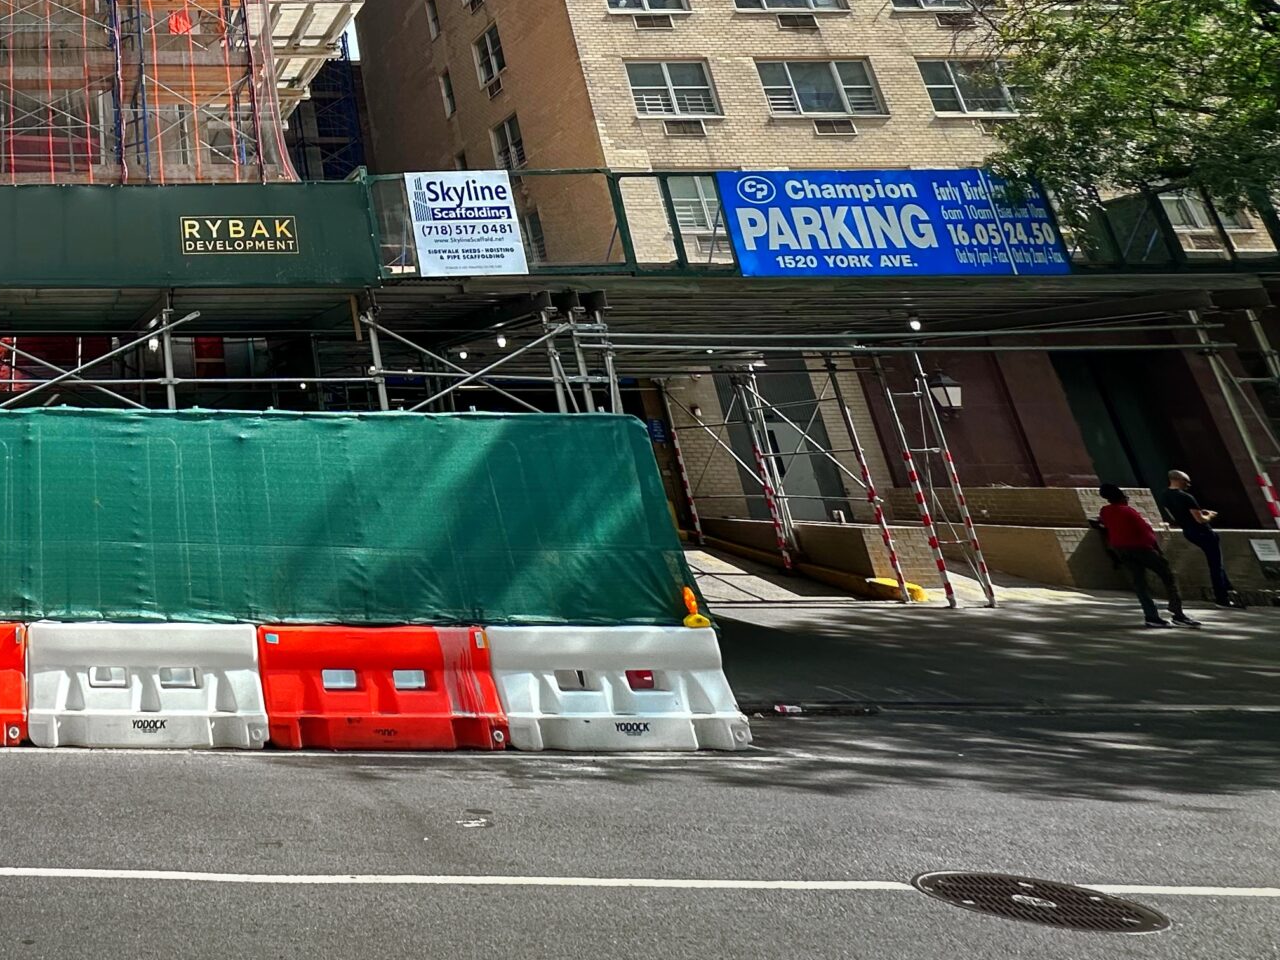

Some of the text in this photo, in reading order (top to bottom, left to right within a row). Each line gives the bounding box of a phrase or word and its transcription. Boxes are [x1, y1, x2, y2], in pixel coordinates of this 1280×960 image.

[426, 179, 507, 208] Skyline
[785, 179, 918, 202] Champion
[932, 180, 961, 205] Early
[960, 180, 987, 201] Bird
[434, 208, 508, 220] Scaffolding
[941, 205, 993, 220] 6am 10am
[184, 219, 293, 239] RYBAK
[422, 224, 513, 237] (718) 517.0481
[736, 204, 939, 251] PARKING
[946, 223, 1002, 246] 16.05
[1003, 222, 1056, 245] 24.50
[185, 240, 294, 251] DEVELOPMENT
[484, 246, 515, 254] HOISTING
[776, 254, 919, 268] 1520 YORK AVE.
[132, 719, 168, 729] YODOCK
[615, 722, 650, 732] YODOCK
